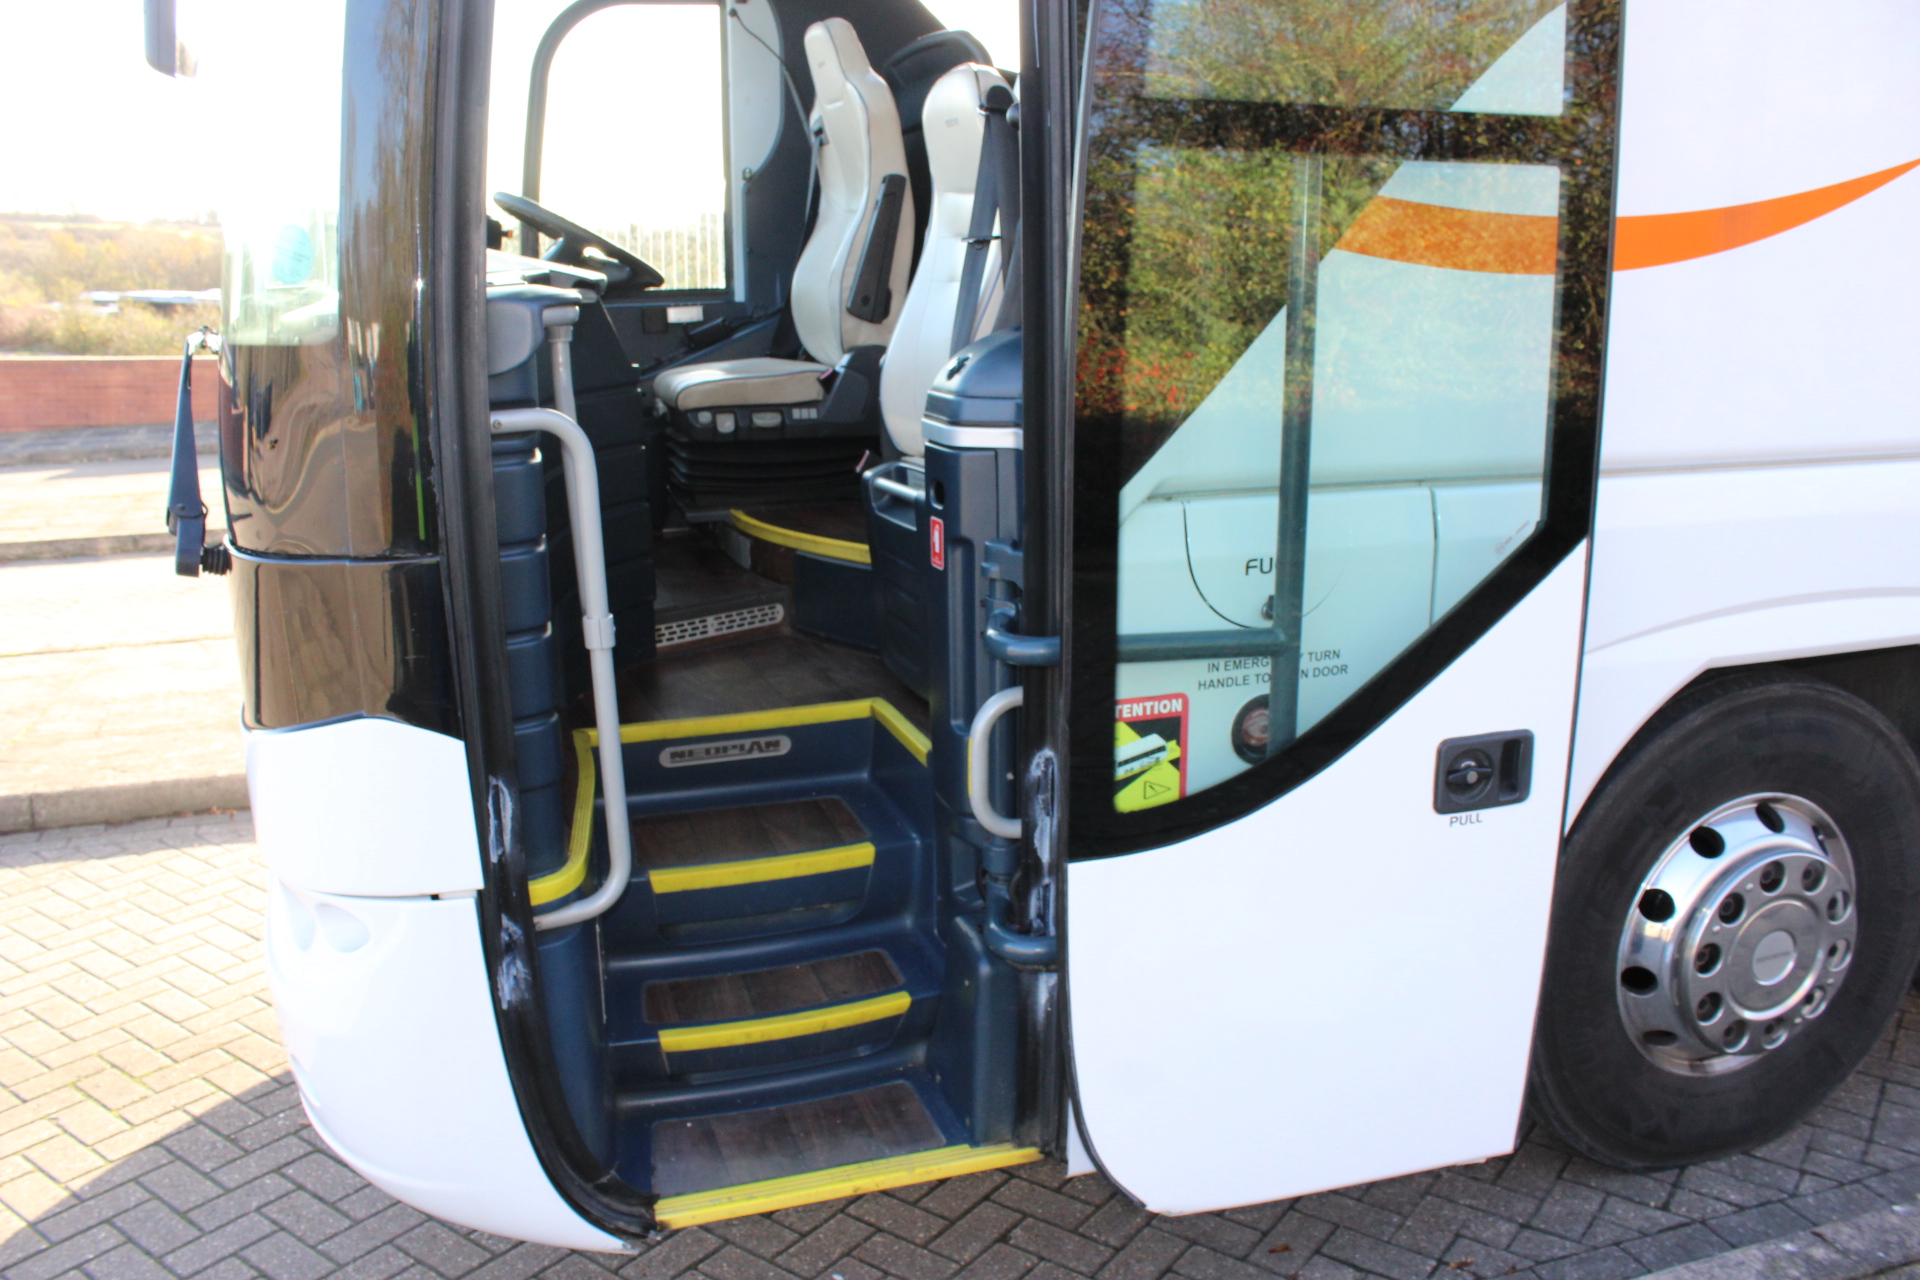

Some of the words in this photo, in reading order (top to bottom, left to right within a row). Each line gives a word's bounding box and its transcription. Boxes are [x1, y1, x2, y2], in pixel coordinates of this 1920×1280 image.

[1245, 557, 1274, 576] FU
[1207, 662, 1220, 674] IN
[1307, 649, 1341, 662] TURN
[1197, 674, 1250, 691] HANDLE
[1254, 672, 1272, 685] TO
[1312, 664, 1348, 678] DOOR
[1115, 698, 1183, 719] TENTION
[670, 740, 781, 763] NEOPLAN
[1449, 813, 1483, 827] PULL
